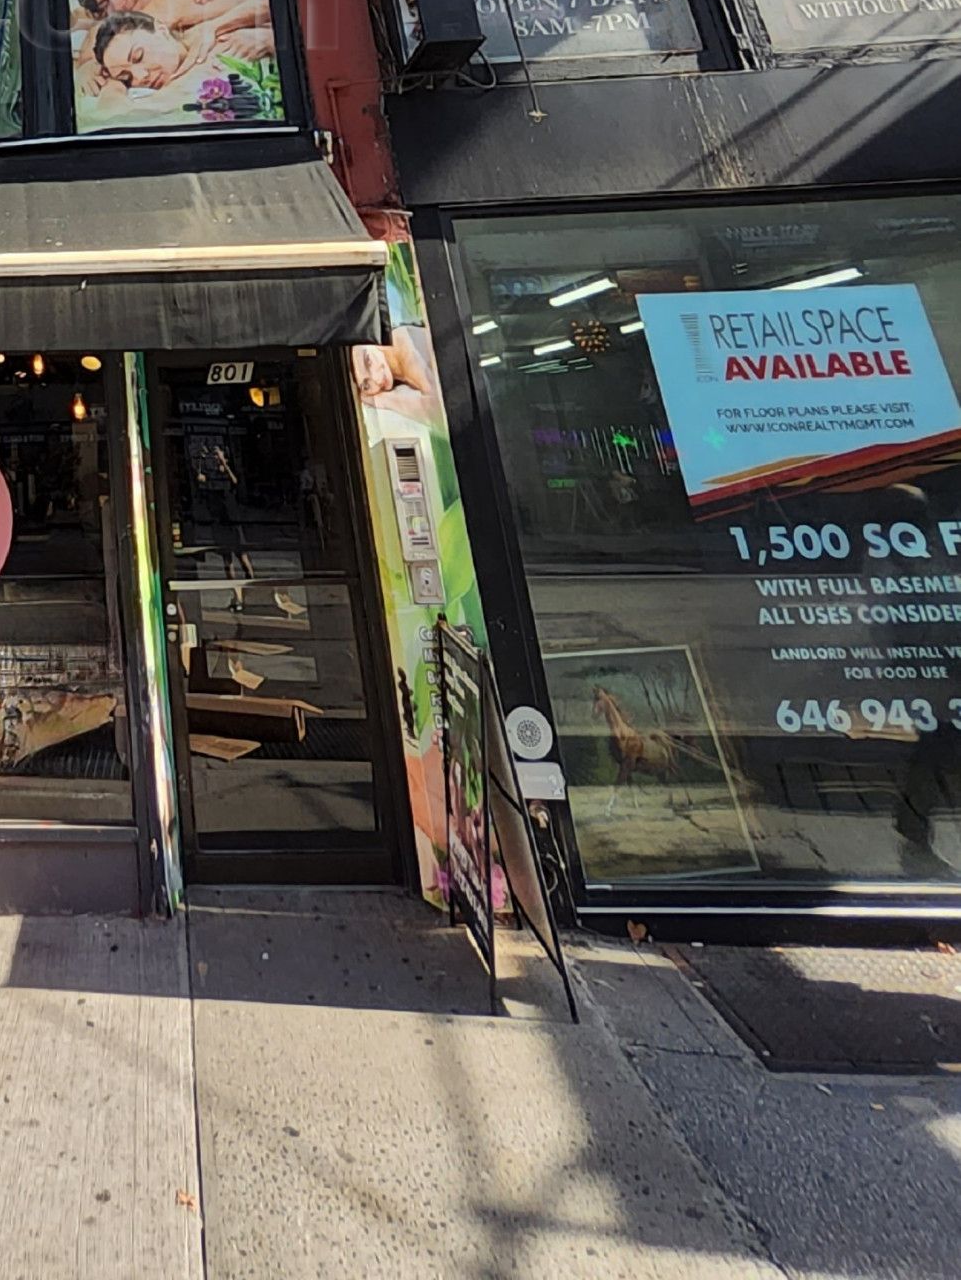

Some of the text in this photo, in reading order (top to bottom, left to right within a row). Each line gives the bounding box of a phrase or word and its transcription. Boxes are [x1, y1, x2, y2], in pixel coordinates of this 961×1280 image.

[515, 17, 575, 37] 8AM
[709, 307, 899, 350] RETAIL SPACE
[211, 364, 248, 381] 801
[725, 350, 912, 381] AVAILABLE
[717, 402, 915, 419] FOR FLOOR PLANS PLEASE VISIT:
[725, 419, 915, 434] WWW.ICONREALTYMGMT.COM
[729, 521, 961, 566] 1,500 SQ F
[755, 579, 812, 596] WITH
[817, 577, 867, 595] FULL
[758, 607, 795, 625] ALL
[799, 606, 852, 624] USES
[771, 647, 846, 660] LANDLORD
[850, 647, 884, 659] WILL
[887, 646, 941, 659] INSTALL
[844, 666, 948, 679] FOR FOOD USE
[776, 699, 851, 733] 646
[860, 698, 937, 731] 943
